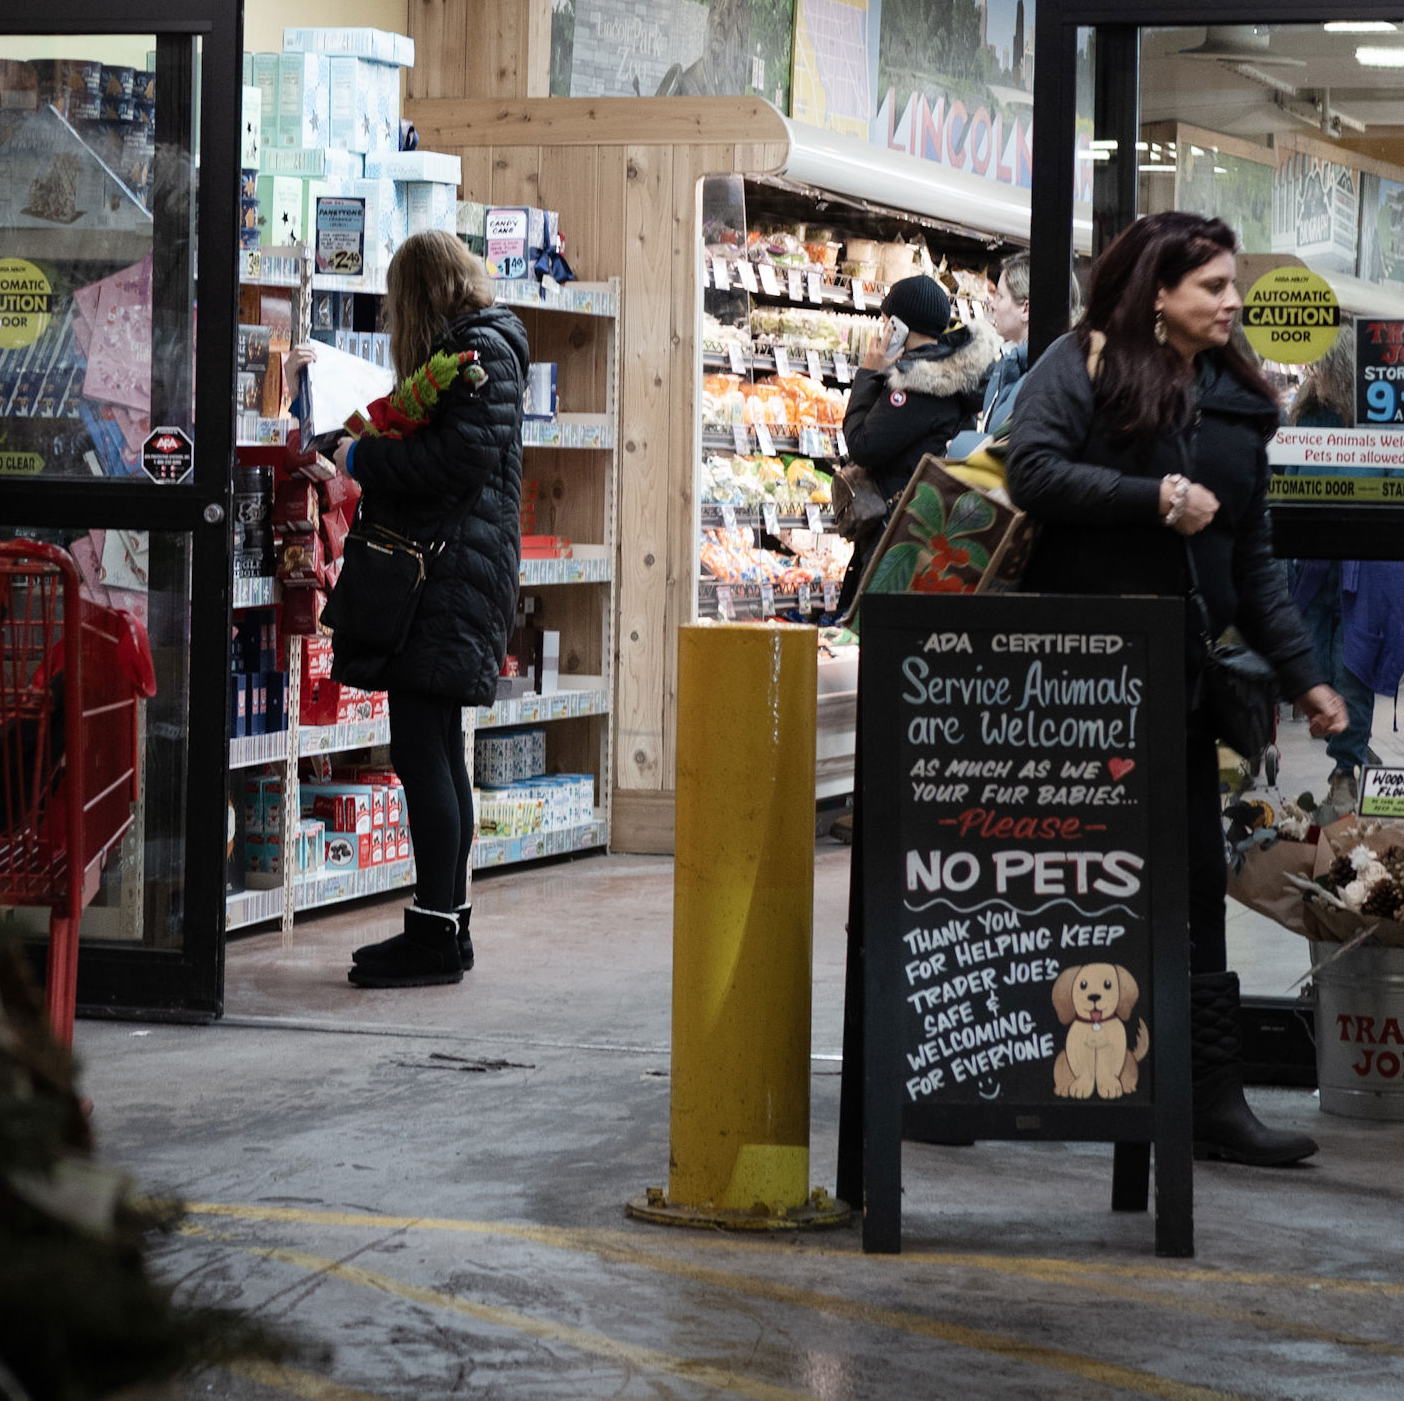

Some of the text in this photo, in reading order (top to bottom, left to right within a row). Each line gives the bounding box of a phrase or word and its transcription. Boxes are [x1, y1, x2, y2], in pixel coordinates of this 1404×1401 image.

[631, 15, 662, 57] Park
[1252, 291, 1331, 303] AUTOMATIC
[1, 316, 27, 327] OOR
[1249, 308, 1334, 325] CAUTION
[1271, 331, 1311, 342] DOOR
[1276, 432, 1322, 446] Service
[1327, 433, 1376, 448] Animals
[6, 456, 35, 470] CLEAR
[1305, 449, 1332, 462] Pets
[1336, 450, 1356, 462] not
[1268, 479, 1322, 495] UTOMATIC
[1325, 480, 1355, 496] DOOR
[923, 632, 1124, 654] ADA CERTIFIED
[902, 656, 1143, 711] Service Animals
[908, 707, 1137, 749] are Welcome!
[910, 758, 1102, 779] AS MUCH AS WE
[911, 781, 969, 803] YOUR
[981, 785, 1029, 805] FUR
[905, 849, 1145, 898] NO PETS
[903, 909, 1021, 956] THANK YOU
[904, 924, 1126, 986] FOR HELPING KEEP
[906, 957, 1060, 1015] TRADER JOE'S
[923, 1000, 975, 1039] SAFE
[906, 1009, 1037, 1072] WELCOMING
[905, 1032, 1056, 1101] FOR EVERYONE
